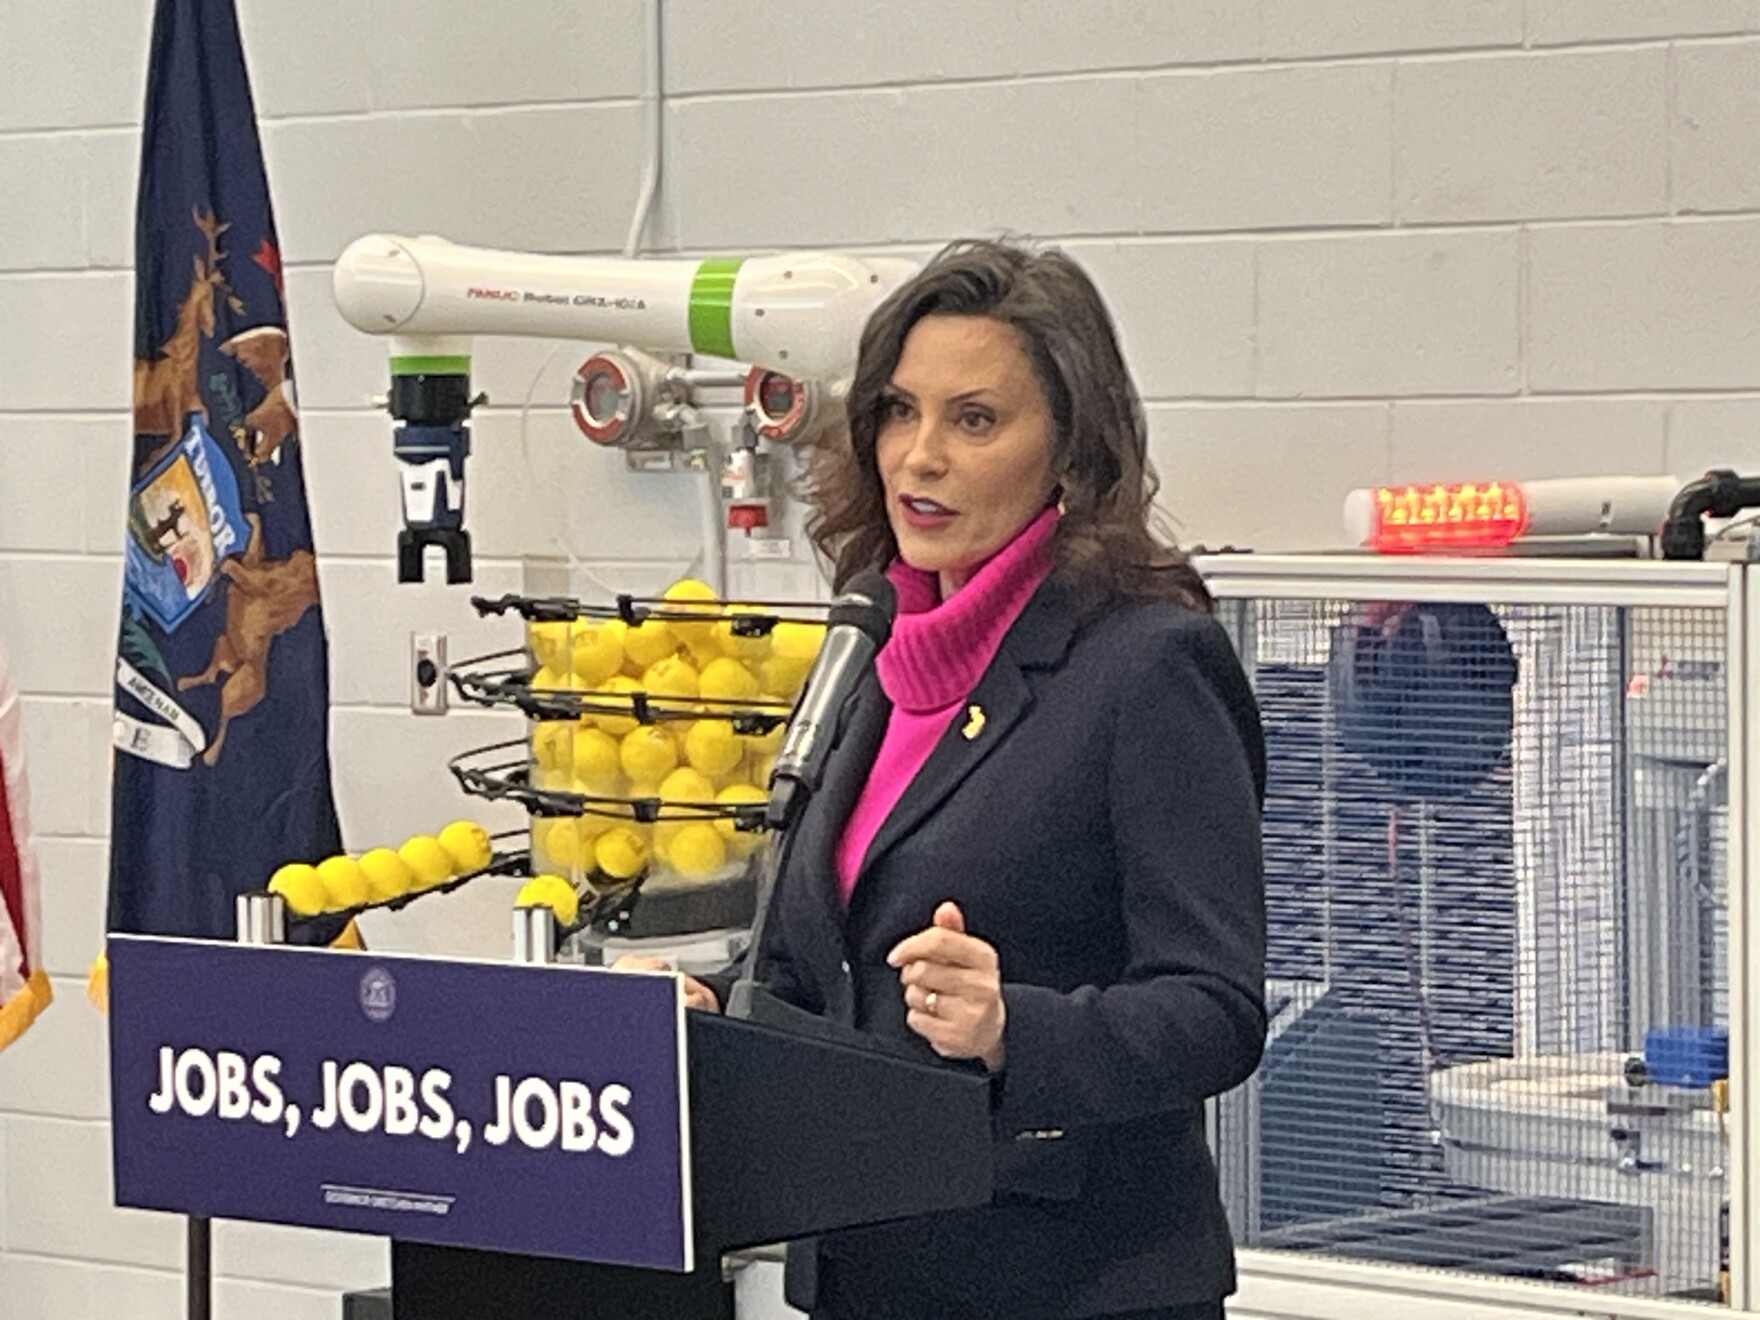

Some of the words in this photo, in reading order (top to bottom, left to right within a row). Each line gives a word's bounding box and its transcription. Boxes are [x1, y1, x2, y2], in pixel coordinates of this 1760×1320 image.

[149, 1045, 301, 1138] JOBS,
[311, 1060, 473, 1154] JOBS,
[484, 1074, 635, 1156] JOBS
